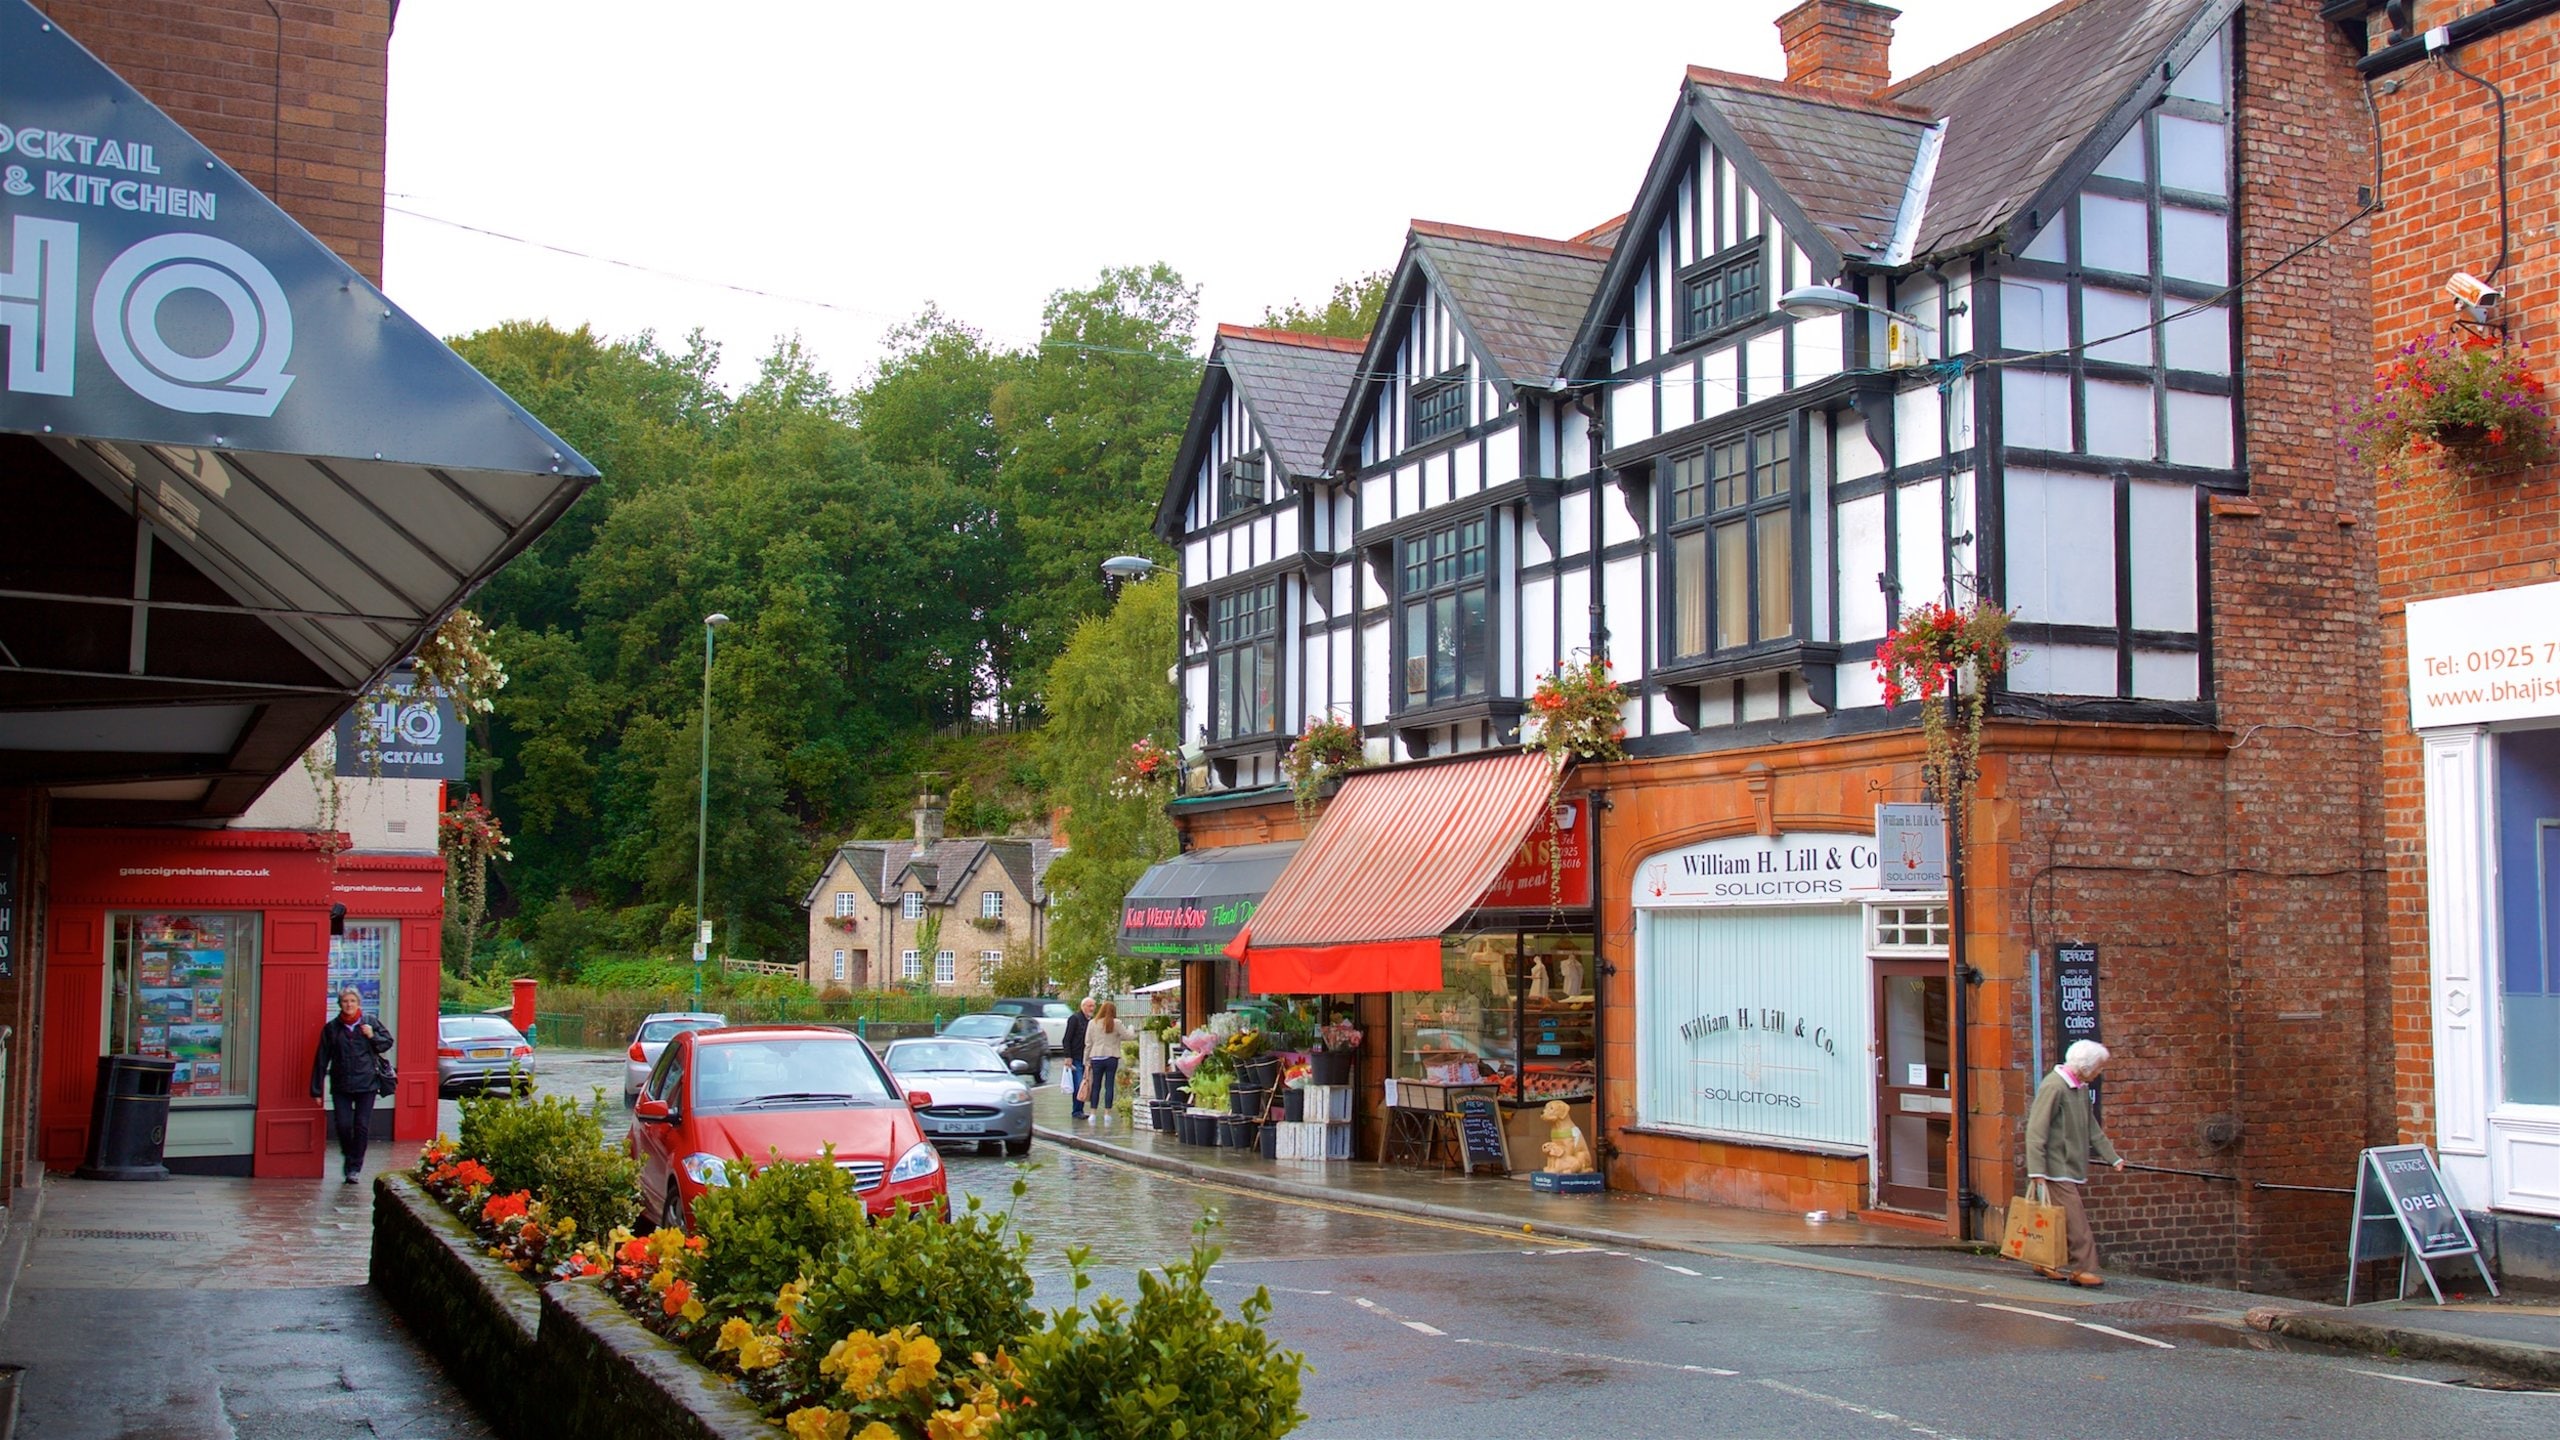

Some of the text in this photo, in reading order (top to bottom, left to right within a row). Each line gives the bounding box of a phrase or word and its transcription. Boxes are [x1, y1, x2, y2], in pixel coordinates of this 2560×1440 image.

[3, 165, 216, 220] & KITCHEN
[2424, 655, 2459, 677] Tel:
[2467, 645, 2534, 672] 01925
[360, 703, 442, 745] HQ
[1683, 853, 1749, 876] William
[1757, 850, 1777, 874] H.
[1785, 848, 1818, 872] Lill
[1826, 846, 1842, 870] &
[120, 867, 270, 877] gascoignehalman.co.uk
[1517, 869, 1547, 889] meat
[1887, 872, 1940, 881] SOLICITORS
[1715, 880, 1842, 896] SOLICITORS
[1174, 907, 1184, 928] &
[2060, 975, 2092, 986] Breakfast
[2063, 986, 2091, 999] Lunch
[2062, 999, 2094, 1011] Coffee
[2065, 1016, 2095, 1029] Cakes
[1680, 1008, 1835, 1057] William H. Lill & Co.
[1704, 1088, 1801, 1108] SOLICITORS
[2401, 1193, 2446, 1211] OPEN
